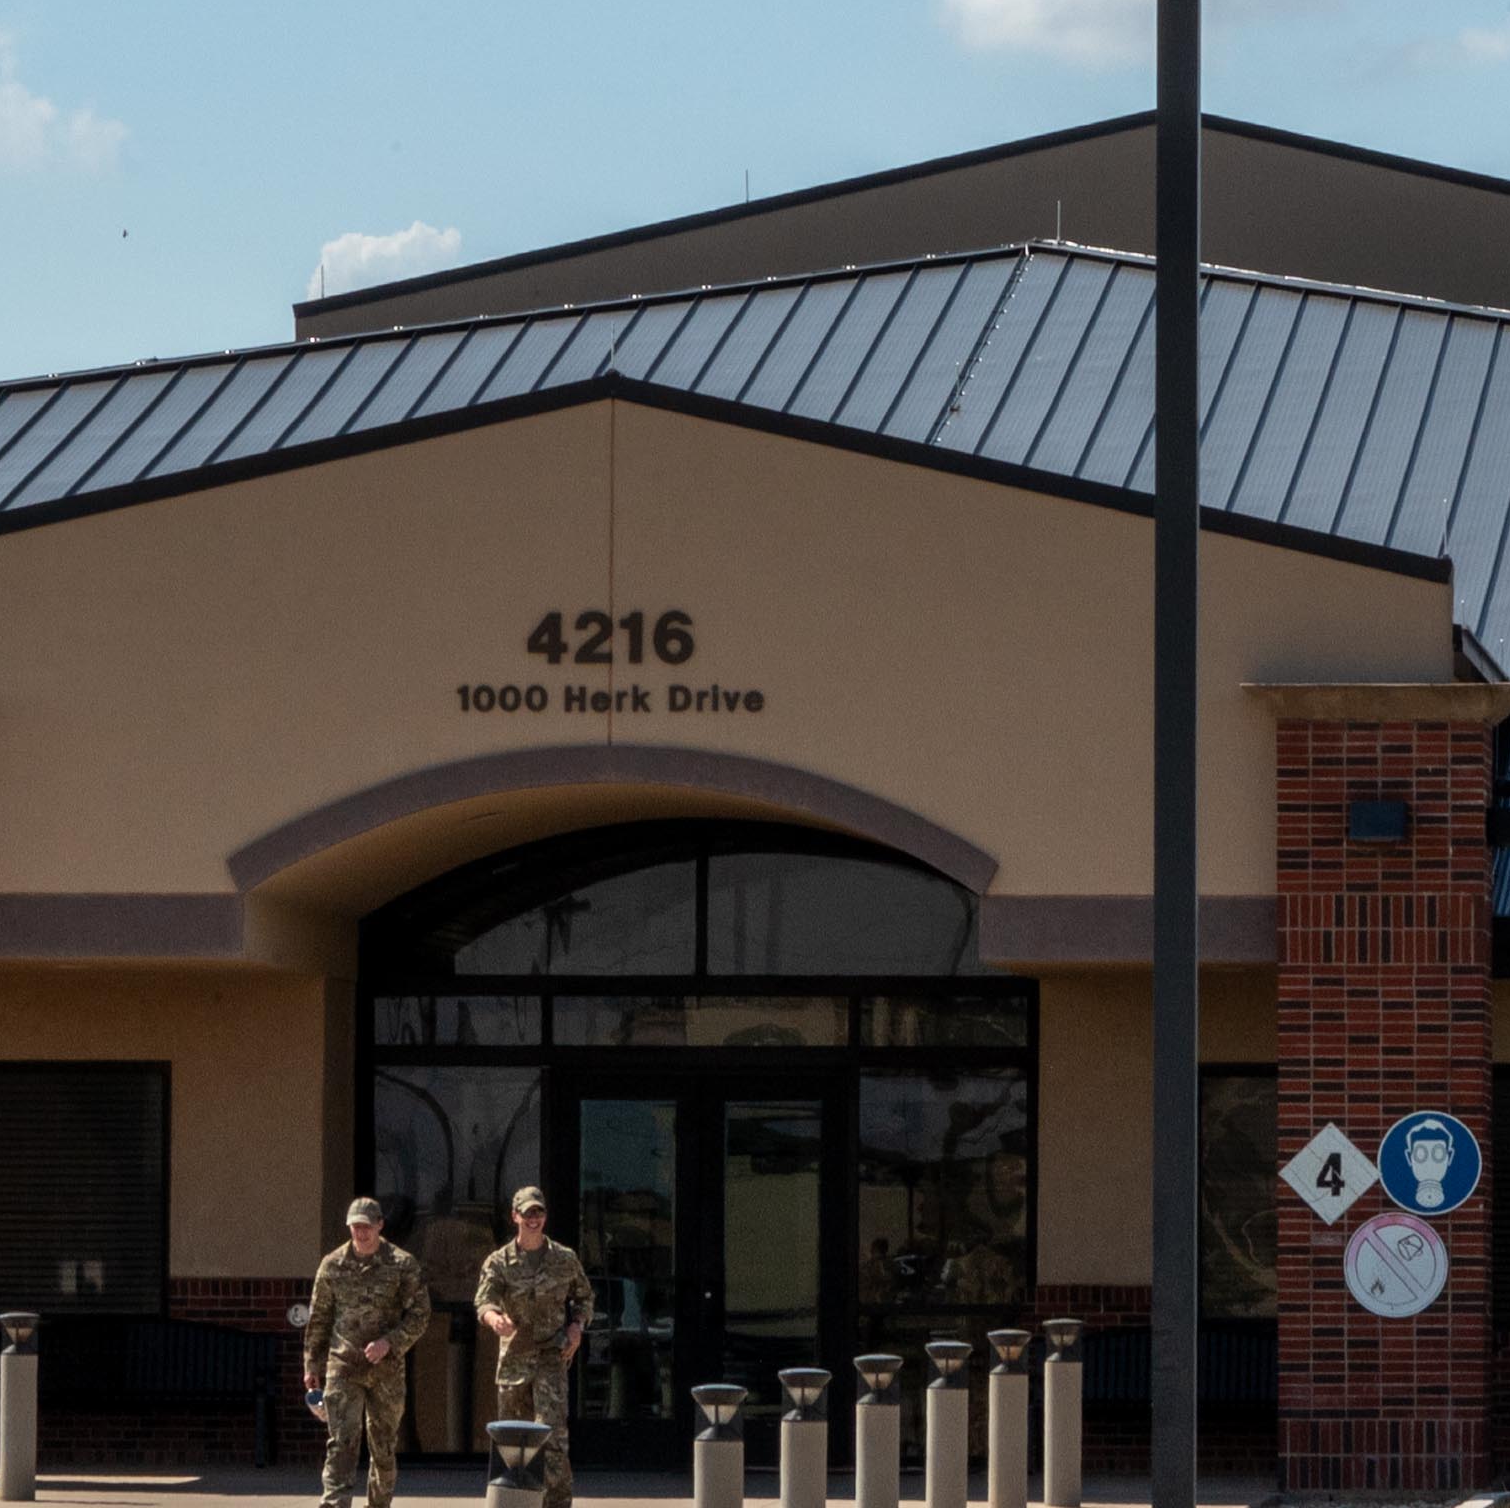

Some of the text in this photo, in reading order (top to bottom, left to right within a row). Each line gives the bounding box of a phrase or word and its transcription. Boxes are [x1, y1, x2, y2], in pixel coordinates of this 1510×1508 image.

[527, 610, 695, 665] 4216
[456, 684, 765, 713] 1000 Herk Drive
[1316, 1152, 1345, 1197] 4
